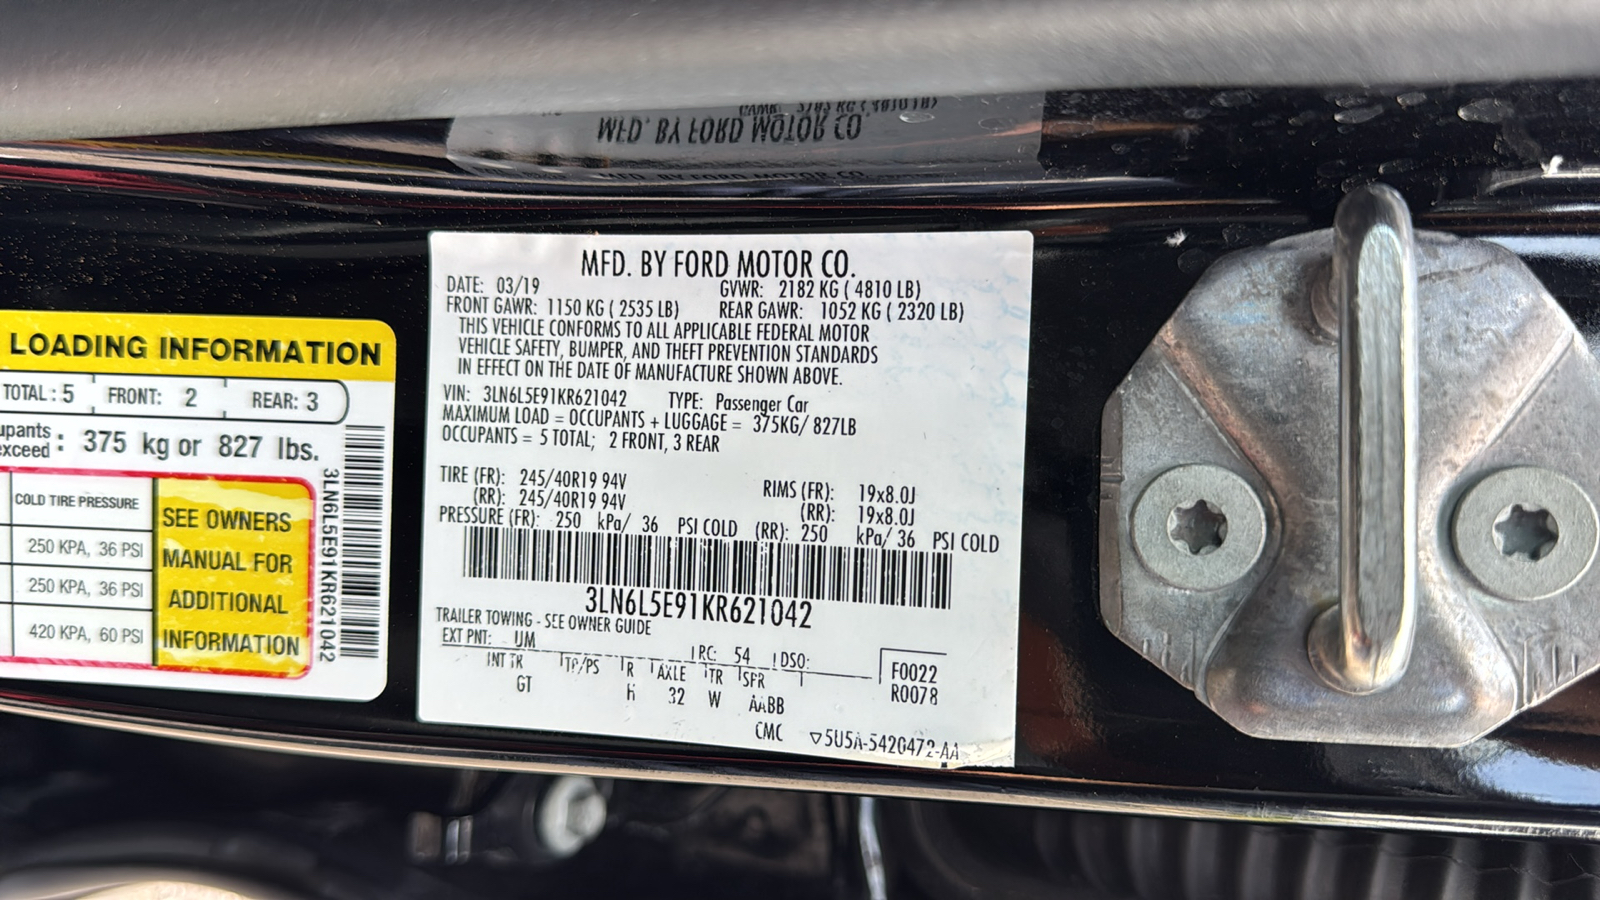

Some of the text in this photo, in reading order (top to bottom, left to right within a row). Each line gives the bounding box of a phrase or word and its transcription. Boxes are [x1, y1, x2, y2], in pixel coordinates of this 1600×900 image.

[581, 250, 856, 278] MFD. BY FORD MOTOR CO.
[446, 276, 540, 295] DATE: 03/19
[720, 280, 763, 299] GVWR:
[779, 280, 814, 299] 2182
[820, 280, 839, 299] KG
[897, 280, 921, 301] LB)
[446, 296, 489, 314] FRONT
[494, 297, 537, 315] GAWR:
[548, 299, 581, 317] 1150
[587, 300, 604, 318] KG
[657, 300, 679, 320] LB)
[720, 301, 753, 320] REAR
[758, 301, 803, 320] GAWR:
[821, 301, 856, 320] 1052
[862, 301, 881, 321] KG
[941, 301, 964, 323] LB)
[459, 317, 870, 343] THIS VEHICLE CONFORMS TO ALL APPLICABLE FEDERAL MOTOR
[10, 332, 382, 367] LOADING INFORMATION
[458, 337, 878, 364] VEHICLE SAFETY, BUMPER, AND THEFT PREVENTION STANDARDS
[458, 357, 843, 386] IN EFFECT ON THE DATE OF MANUFACTURE SHOWN ABOVE.
[62, 384, 74, 403] 5
[108, 386, 162, 406] FRONT:
[185, 388, 197, 408] 2
[252, 391, 298, 411] REAR:
[306, 391, 319, 412] 3
[443, 384, 809, 415] VIN: 3LN6L5E91KR621042 TYPE: Passenger Car
[442, 404, 510, 423] MAXIMUM
[515, 406, 550, 425] LOAD
[569, 408, 645, 428] OCCUPANTS
[664, 412, 728, 431] LUGGAGE
[84, 429, 320, 462] 375 kg or 827 lbs.
[442, 425, 720, 454] OCCUPANTS 5 TOTAL; 2 FRONT, 3 REAR
[440, 465, 627, 490] TIRE (FR): 245/40R19 94V
[15, 493, 139, 510] COLD TIRE PRESSURE
[473, 486, 627, 511] (RR): 245/40R19 94V
[763, 479, 916, 505] RIMS (FR): 19x8.0J
[163, 507, 292, 533] SEE OWNERS
[800, 503, 915, 527] (RR): 19x8.0J
[439, 506, 504, 525] PRESSURE
[509, 507, 540, 528] (FR):
[555, 511, 582, 529] 250
[642, 515, 659, 533] 36
[678, 517, 698, 535] PSI
[703, 518, 738, 538] COLD
[755, 520, 789, 542] (RR):
[800, 524, 828, 543] 250
[897, 529, 915, 548] 36
[933, 531, 955, 551] PSI
[960, 533, 1000, 553] COLD
[28, 538, 144, 558] 250 KPA, 36 PSI
[163, 549, 293, 574] MANUAL FOR
[319, 468, 340, 663] 3LN6L5E91KR621042
[29, 577, 144, 598] 250 KPA, 36 PSI
[168, 589, 288, 614] ADDITIONAL
[585, 586, 813, 629] 3LN6L5E91KR621042
[436, 606, 652, 636] TRAILER TOWING SEE OWNER GUIDE
[29, 624, 144, 645] 420 KPA, 60 PSI
[163, 629, 300, 656] INFORMATION
[442, 627, 462, 643] EXT
[467, 628, 492, 645] PNT:
[514, 630, 536, 648] UM
[698, 644, 717, 662] RC:
[734, 646, 751, 665] 54
[487, 651, 506, 667] INT
[510, 653, 523, 669] TR
[627, 661, 634, 677] R
[657, 664, 686, 681] AXLE
[709, 668, 723, 685] TR
[891, 661, 938, 684] F0022
[516, 675, 532, 693] GT
[668, 687, 685, 705] 32
[708, 690, 721, 708] W
[890, 683, 938, 705] R0078
[755, 721, 784, 742] CMC
